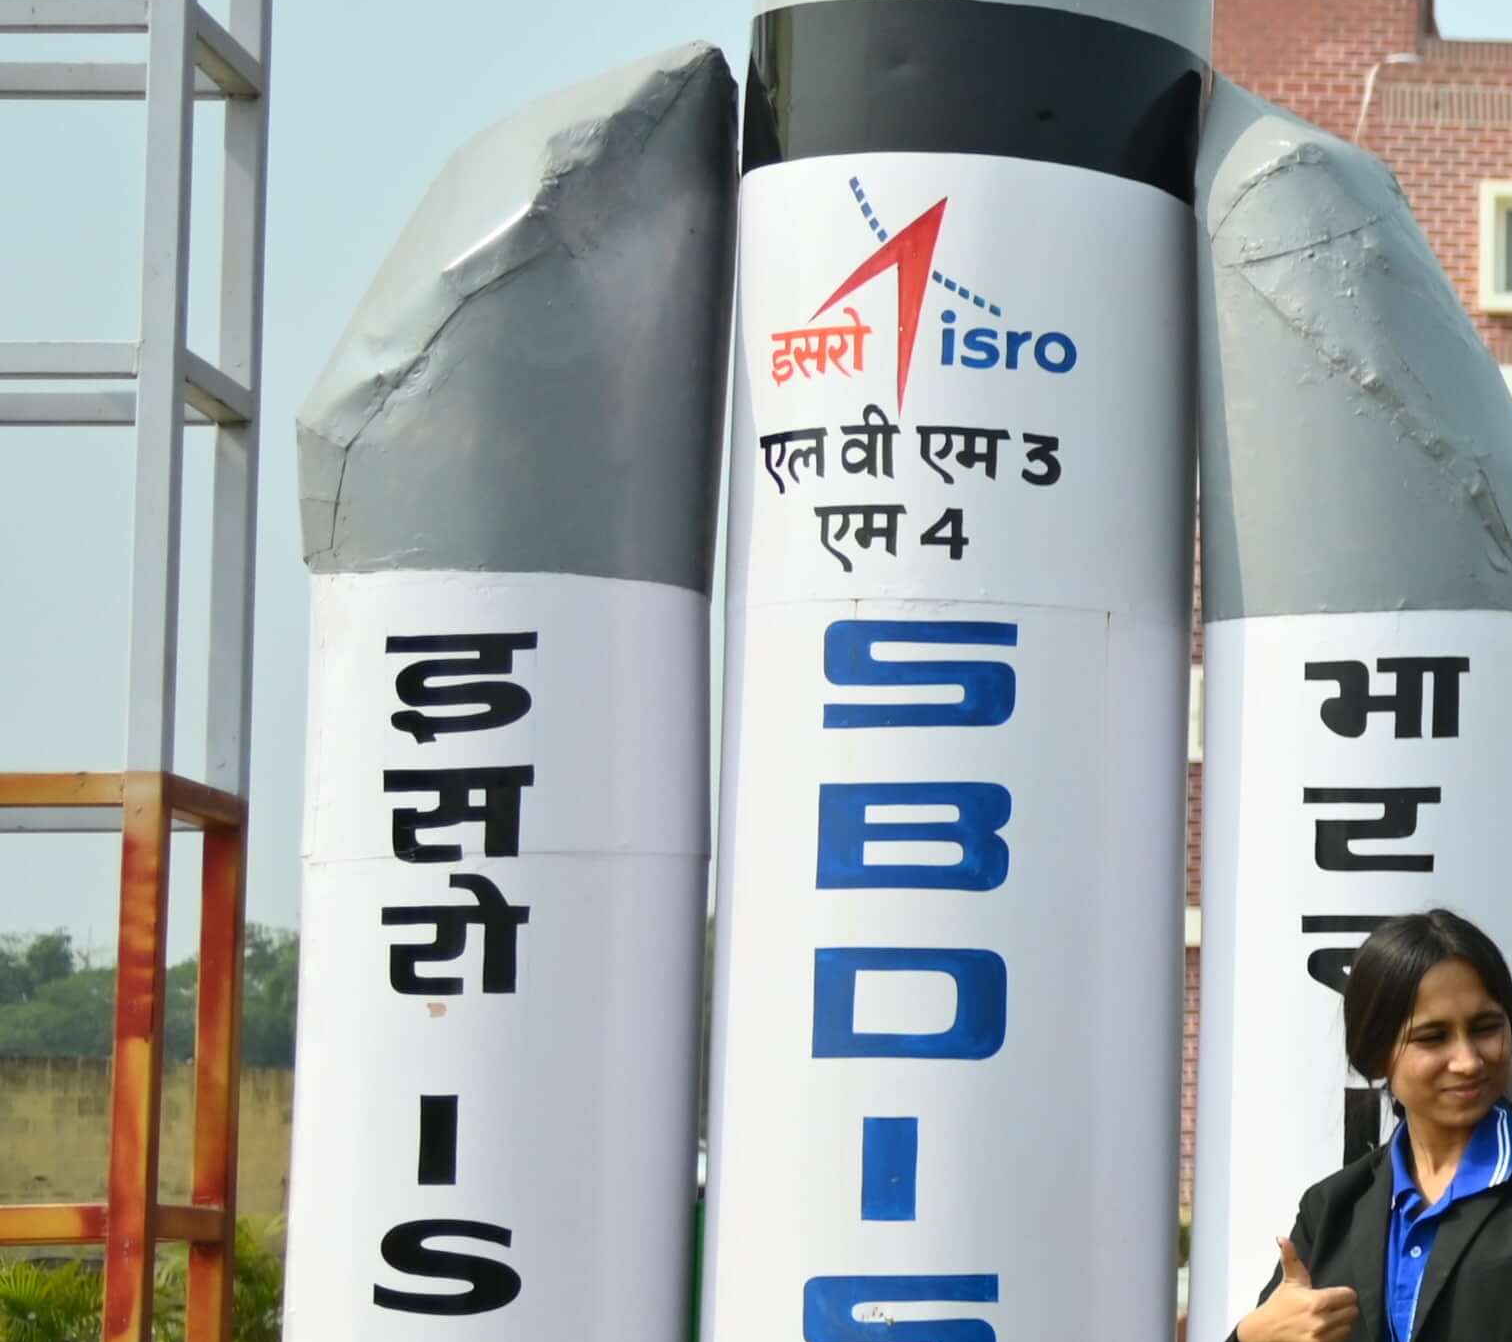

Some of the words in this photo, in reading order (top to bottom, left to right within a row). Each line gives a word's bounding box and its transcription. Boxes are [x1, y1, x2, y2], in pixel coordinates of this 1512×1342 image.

[940, 310, 1077, 374] isro
[760, 427, 828, 494] एल
[840, 404, 901, 480] वी
[916, 425, 1010, 484] एम
[1021, 432, 1061, 486] 3
[814, 504, 907, 572] एम
[920, 507, 969, 560] 4
